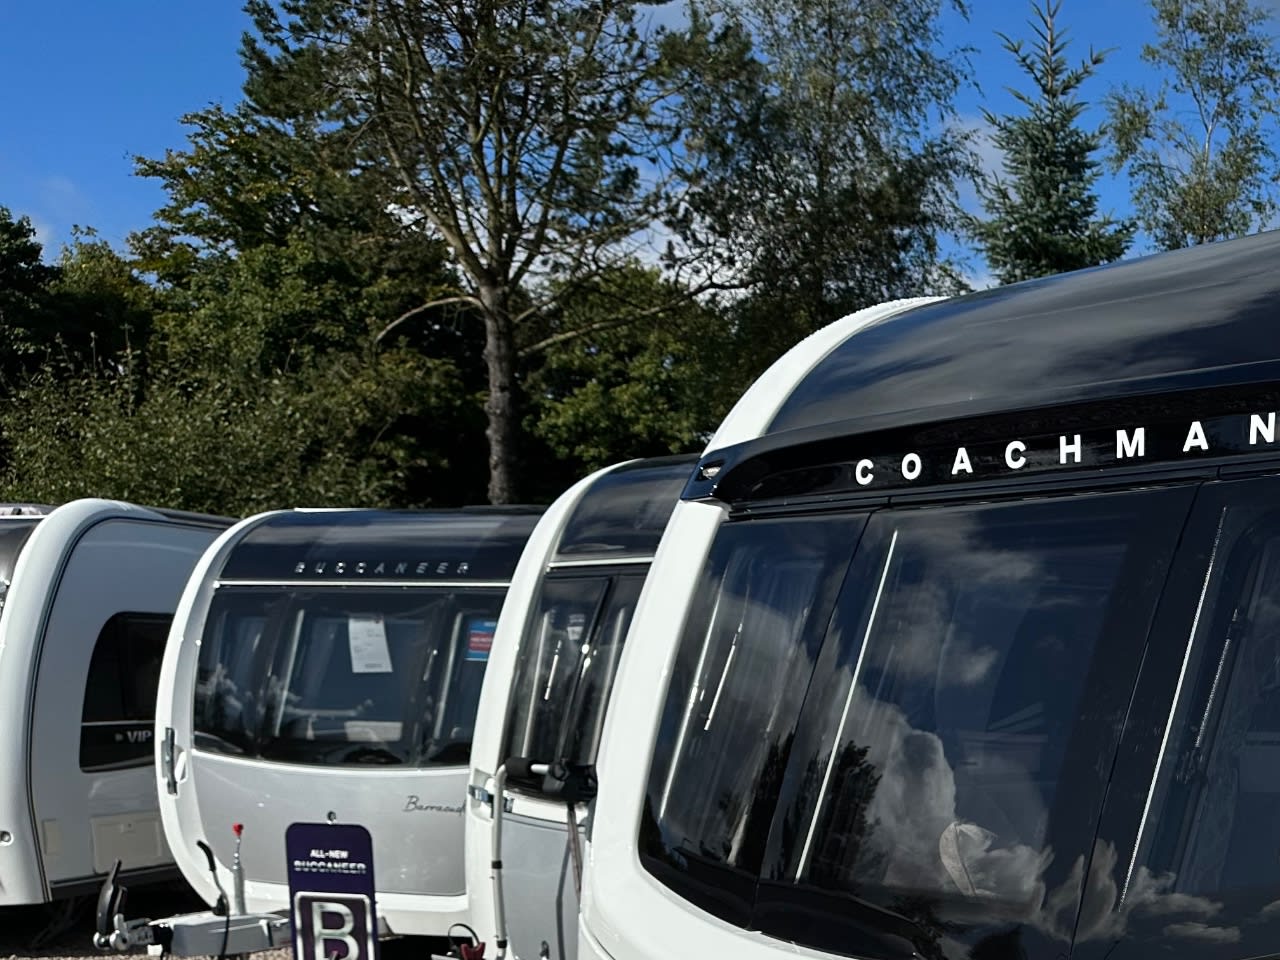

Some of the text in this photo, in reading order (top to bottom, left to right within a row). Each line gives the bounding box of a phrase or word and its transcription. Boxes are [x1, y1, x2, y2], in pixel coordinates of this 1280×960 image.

[855, 411, 1277, 486] COACHMAN
[294, 562, 469, 574] BUCCANEER
[127, 730, 152, 743] VIP
[310, 849, 349, 859] ALL-NEW
[294, 860, 367, 874] BUCCANEER
